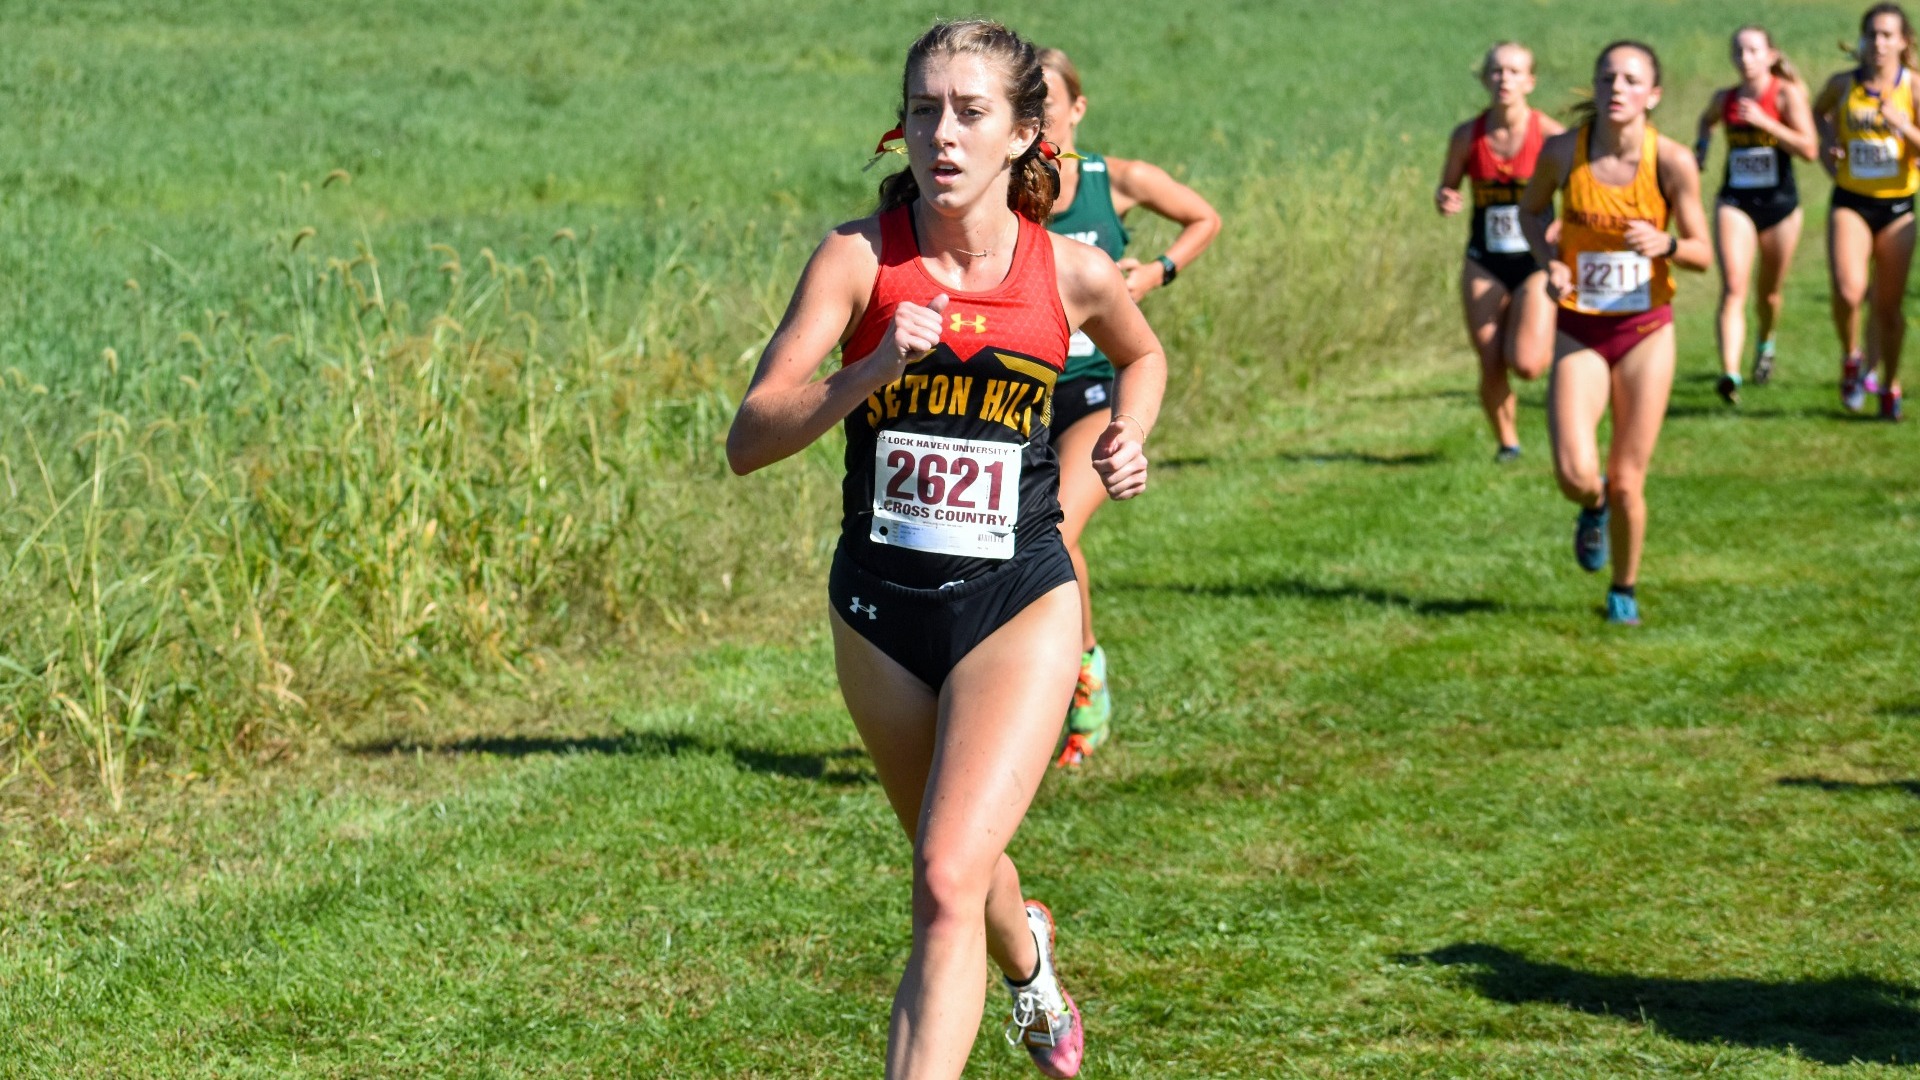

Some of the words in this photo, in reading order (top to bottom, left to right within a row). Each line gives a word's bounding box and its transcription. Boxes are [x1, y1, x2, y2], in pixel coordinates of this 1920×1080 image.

[1583, 262, 1639, 288] 2211
[867, 374, 973, 429] SETON
[888, 436, 913, 447] LOCK
[916, 439, 949, 451] HAVEN
[952, 444, 1008, 455] UNIVERSITY
[885, 449, 1004, 511] 2621
[883, 500, 930, 518] CROSS
[934, 509, 1008, 526] COUNTRY
